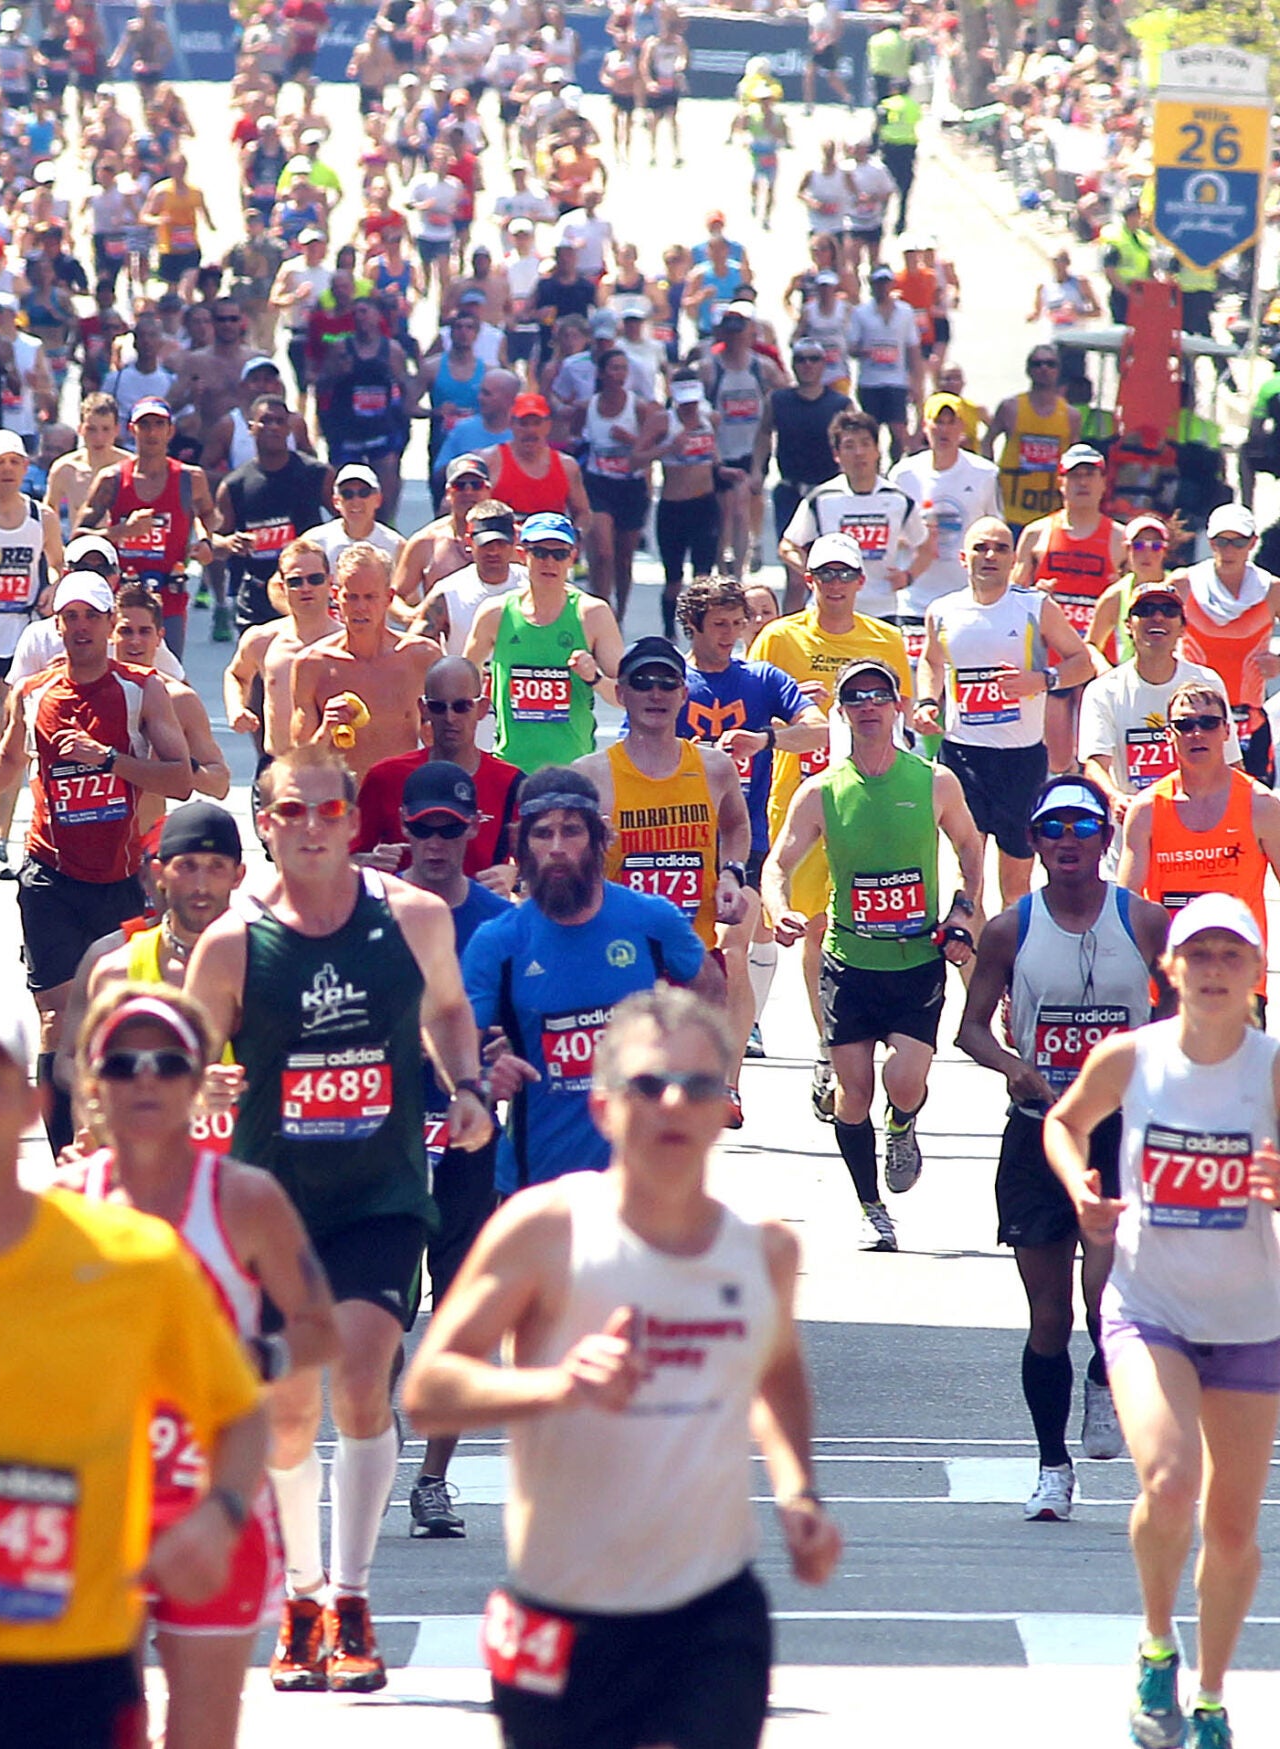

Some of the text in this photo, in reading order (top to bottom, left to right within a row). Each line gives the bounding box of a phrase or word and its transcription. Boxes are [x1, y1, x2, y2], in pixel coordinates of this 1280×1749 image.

[1177, 122, 1241, 166] 26
[1, 548, 34, 564] RZB
[533, 668, 570, 679] adidas
[512, 680, 567, 701] 3083
[960, 682, 1009, 702] 778
[57, 773, 116, 801] 5727
[655, 854, 701, 867] adidas
[1156, 847, 1230, 864] missouri
[629, 871, 698, 897] 8173
[879, 872, 921, 887] adidas
[858, 887, 918, 913] 5381
[577, 1009, 613, 1026] adid
[1074, 1009, 1127, 1023] adidas
[326, 1046, 385, 1067] adidas
[291, 1067, 382, 1104] 4689
[1185, 1132, 1249, 1153] adidas
[1147, 1151, 1246, 1191] 7790
